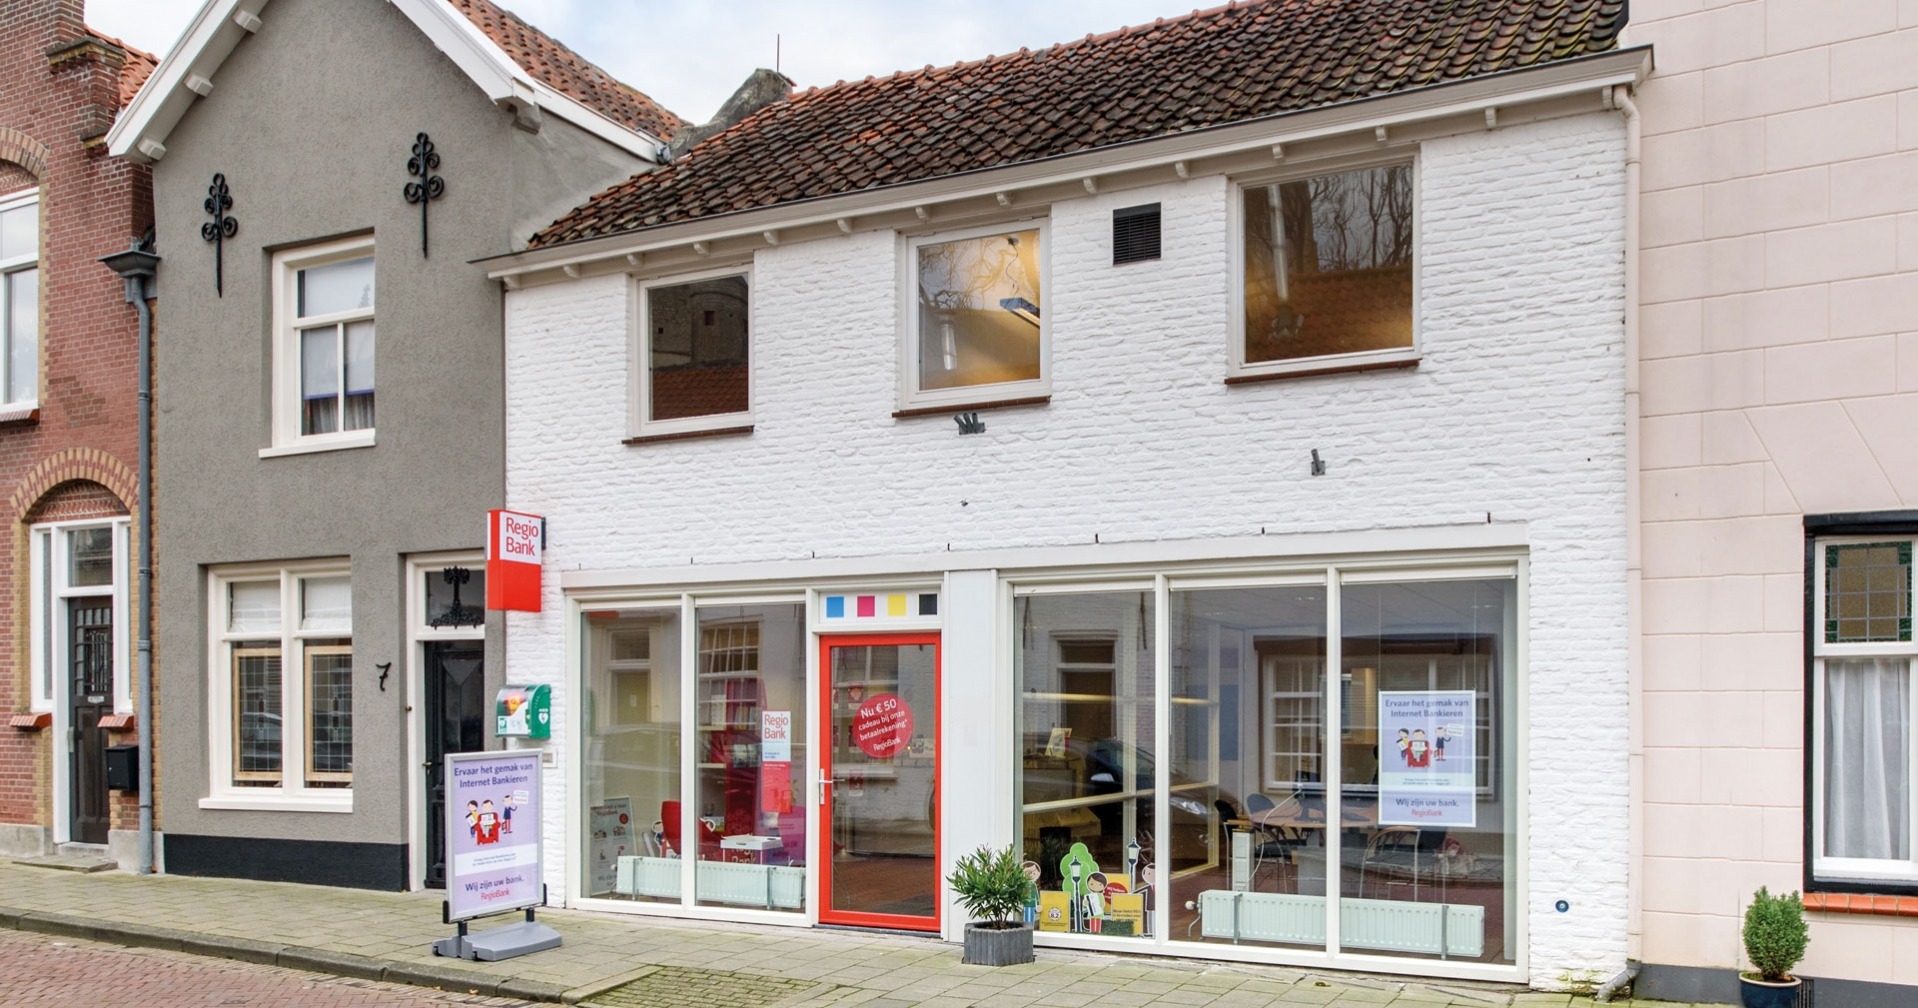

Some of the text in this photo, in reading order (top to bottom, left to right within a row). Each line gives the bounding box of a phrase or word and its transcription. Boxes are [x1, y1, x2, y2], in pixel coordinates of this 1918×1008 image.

[506, 517, 539, 540] Regio
[506, 536, 535, 556] Bank
[375, 661, 392, 692] 7
[860, 698, 897, 719] Nu € 50
[1385, 698, 1469, 708] Ervaar het gemak van
[764, 713, 789, 729] Regio
[858, 710, 906, 731] cadeau bij onze
[1390, 709, 1463, 717] Internet Bankieren
[764, 727, 786, 739] Bank
[873, 736, 902, 752] RegioBank
[454, 767, 479, 777] Ervaar
[480, 765, 493, 775] het
[494, 763, 519, 775] gemak
[459, 775, 528, 788] Internet Bankieren
[1395, 798, 1409, 808] Wij
[1410, 799, 1424, 808] zijn
[1438, 799, 1460, 807] bank.
[465, 881, 479, 892] Wij
[480, 880, 493, 890] zijn
[505, 874, 525, 884] bank.
[480, 888, 511, 901] RegioBank
